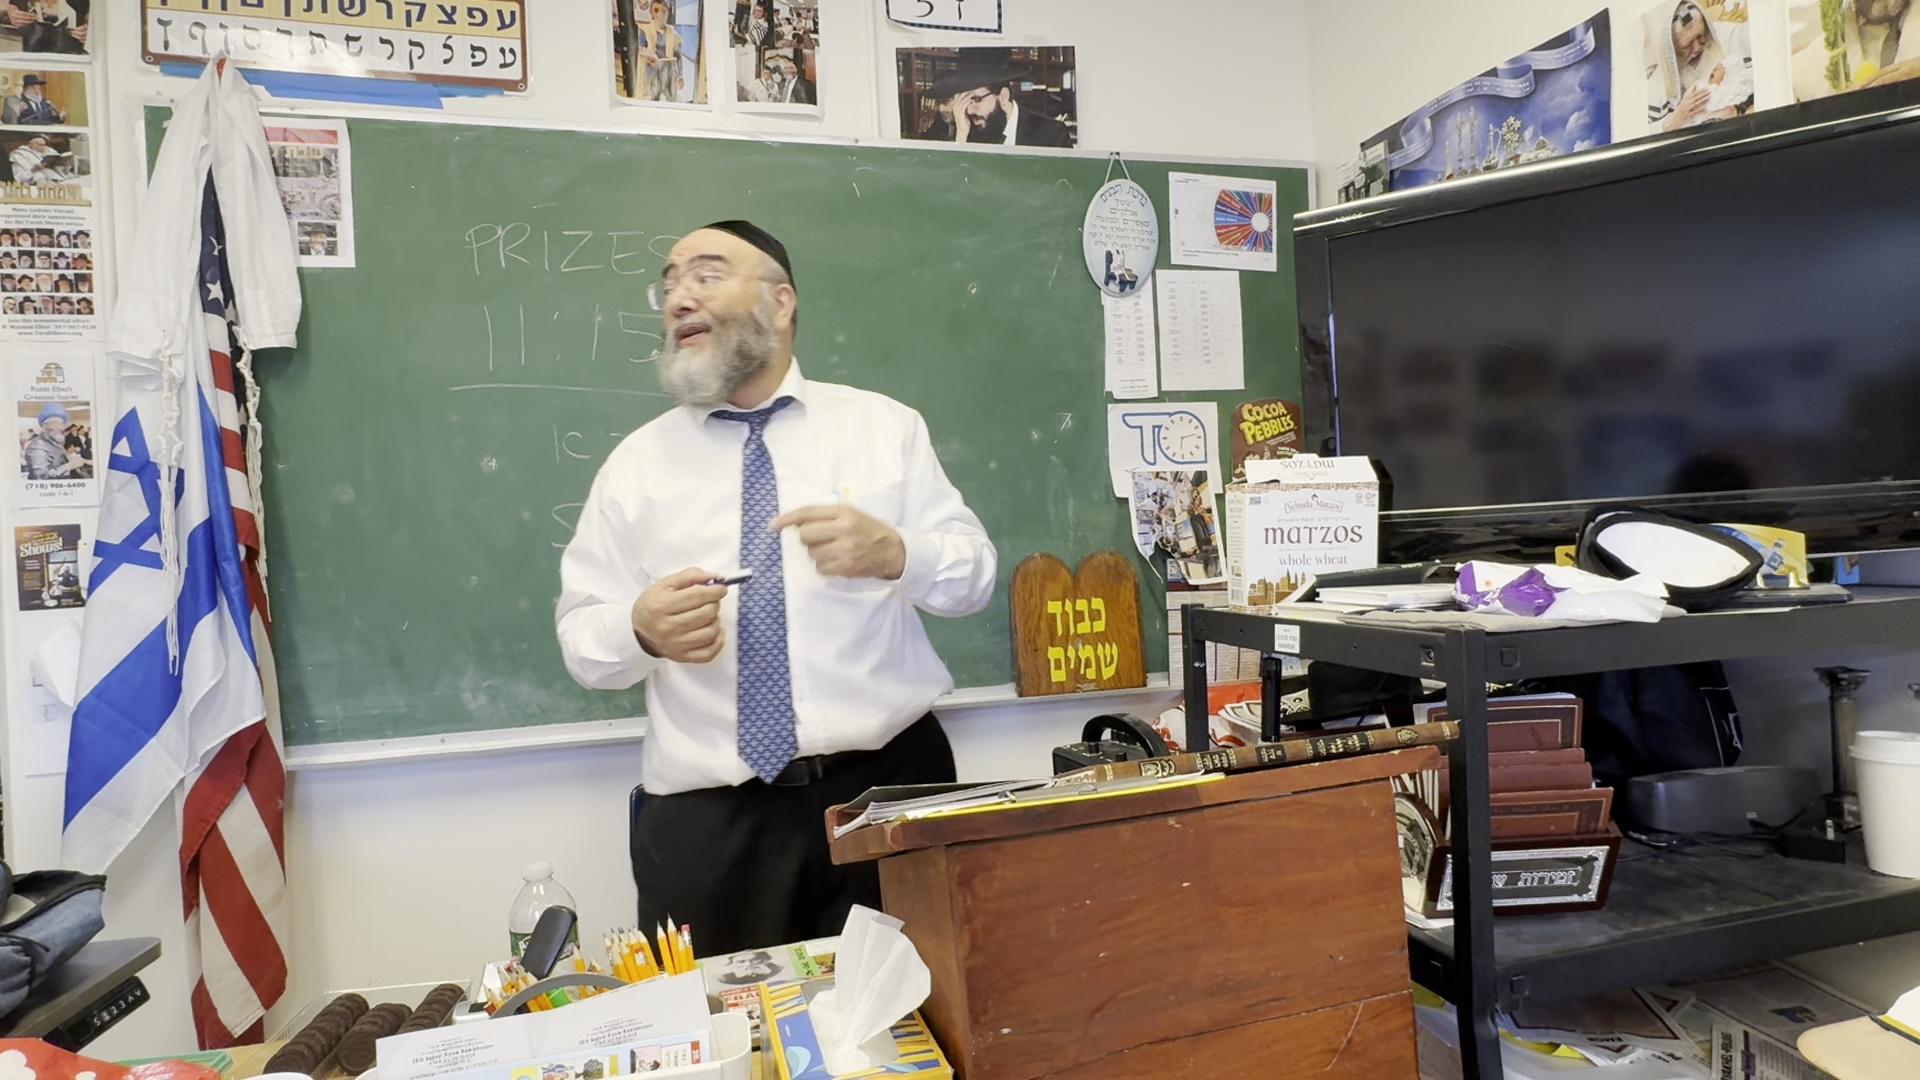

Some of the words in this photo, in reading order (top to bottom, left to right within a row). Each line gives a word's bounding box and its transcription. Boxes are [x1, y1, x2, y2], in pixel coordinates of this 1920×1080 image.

[1241, 401, 1288, 422] COCOA
[1239, 414, 1296, 446] PEBBLES
[1279, 552, 1312, 566] whole
[1314, 551, 1348, 565] wheat
[1047, 596, 1106, 637] כבוד
[1048, 641, 1119, 682] שמים
